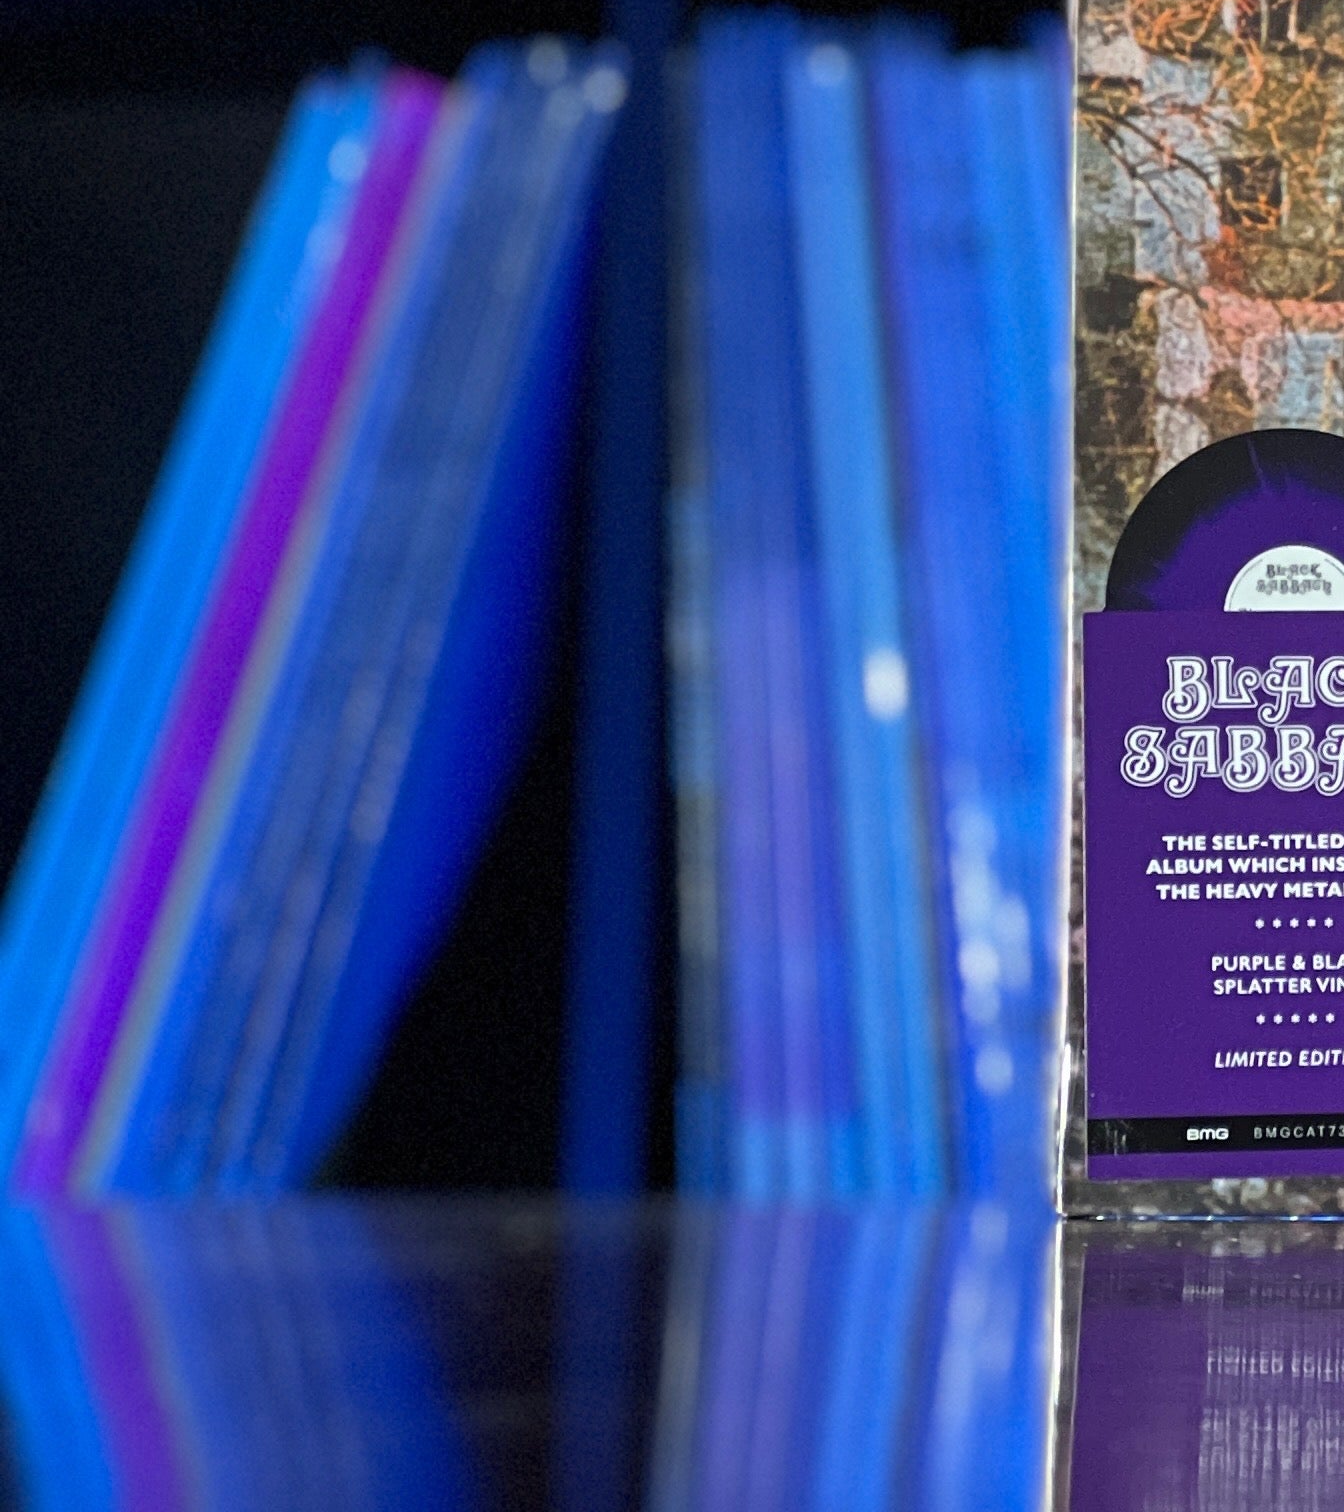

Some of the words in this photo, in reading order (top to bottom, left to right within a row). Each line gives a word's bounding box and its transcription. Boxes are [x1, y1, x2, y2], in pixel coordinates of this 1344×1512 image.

[1162, 835, 1207, 851] THE
[1212, 834, 1344, 851] SELF-TITLED
[1146, 858, 1223, 875] ALBUM
[1228, 857, 1306, 873] WHICH
[1156, 884, 1200, 900] THE
[1206, 882, 1278, 899] HEAVY
[1212, 955, 1286, 971] PURPLE
[1292, 955, 1305, 970] &
[1213, 978, 1312, 995] SPLATTER
[1215, 1050, 1292, 1068] LIMITED
